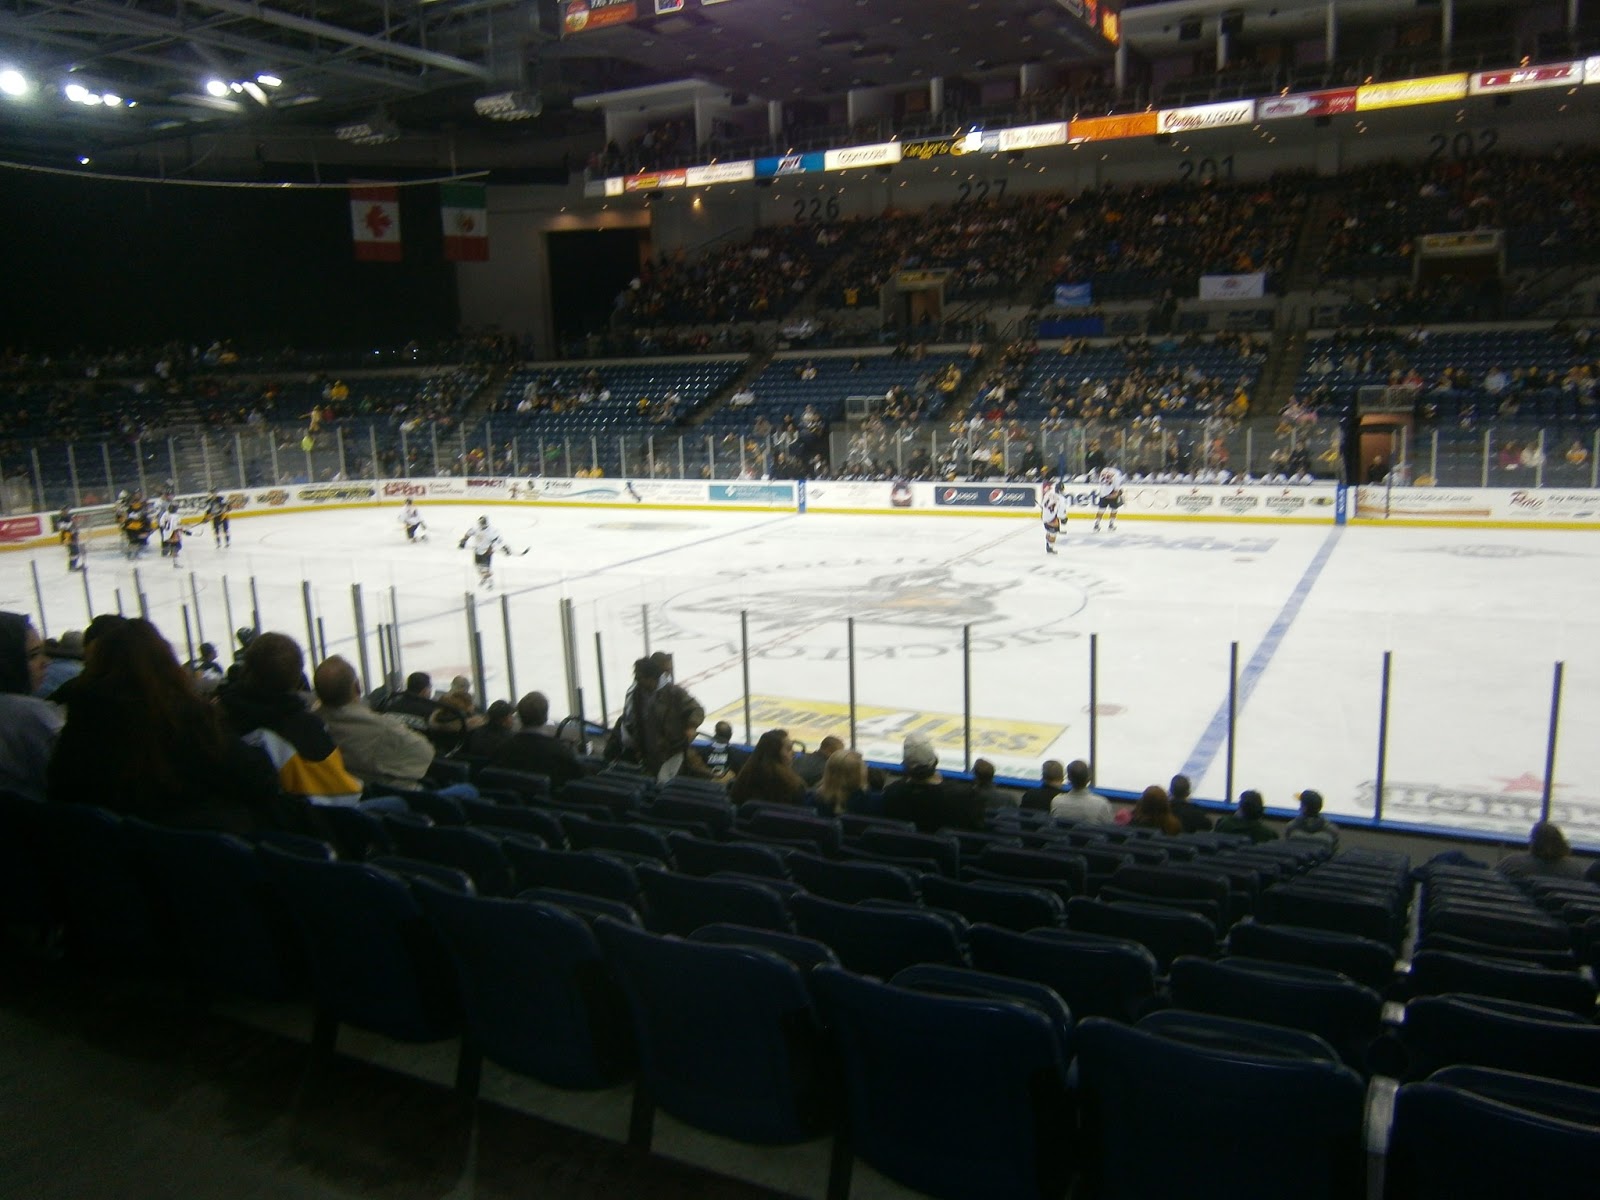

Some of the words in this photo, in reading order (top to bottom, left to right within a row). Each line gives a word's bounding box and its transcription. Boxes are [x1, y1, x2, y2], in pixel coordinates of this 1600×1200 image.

[1428, 129, 1499, 162] 202
[1178, 154, 1235, 182] 201
[957, 179, 1008, 203] 227
[793, 197, 841, 222] 226
